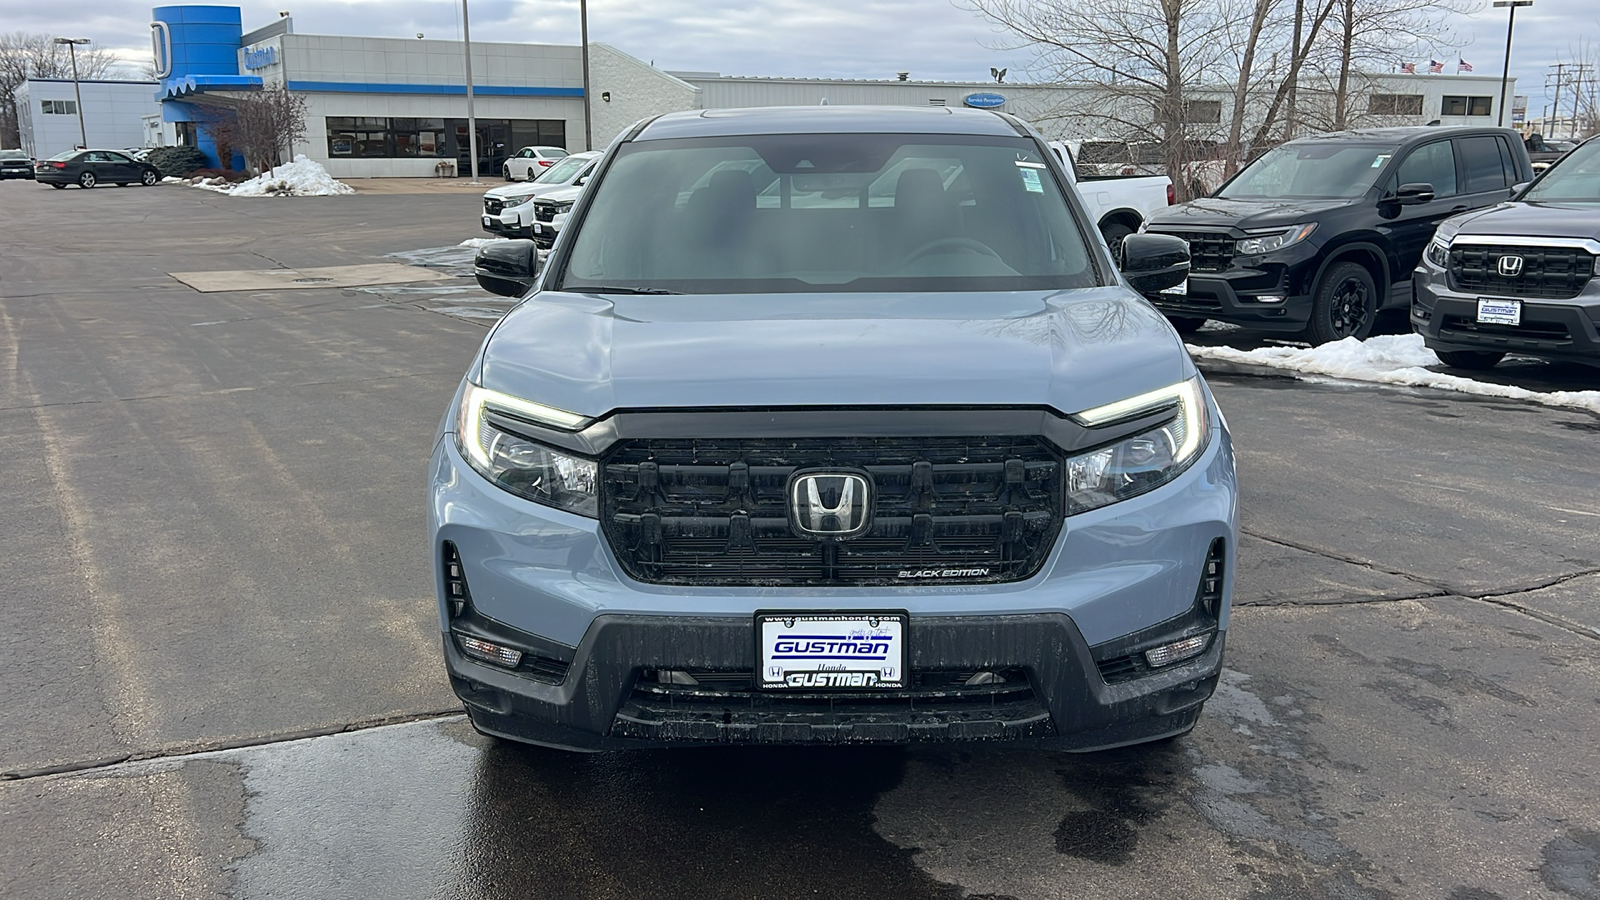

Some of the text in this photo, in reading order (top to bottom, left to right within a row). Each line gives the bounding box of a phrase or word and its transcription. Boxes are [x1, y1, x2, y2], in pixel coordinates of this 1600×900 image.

[898, 568, 990, 578] BLACK EDITION
[817, 663, 847, 671] Honda
